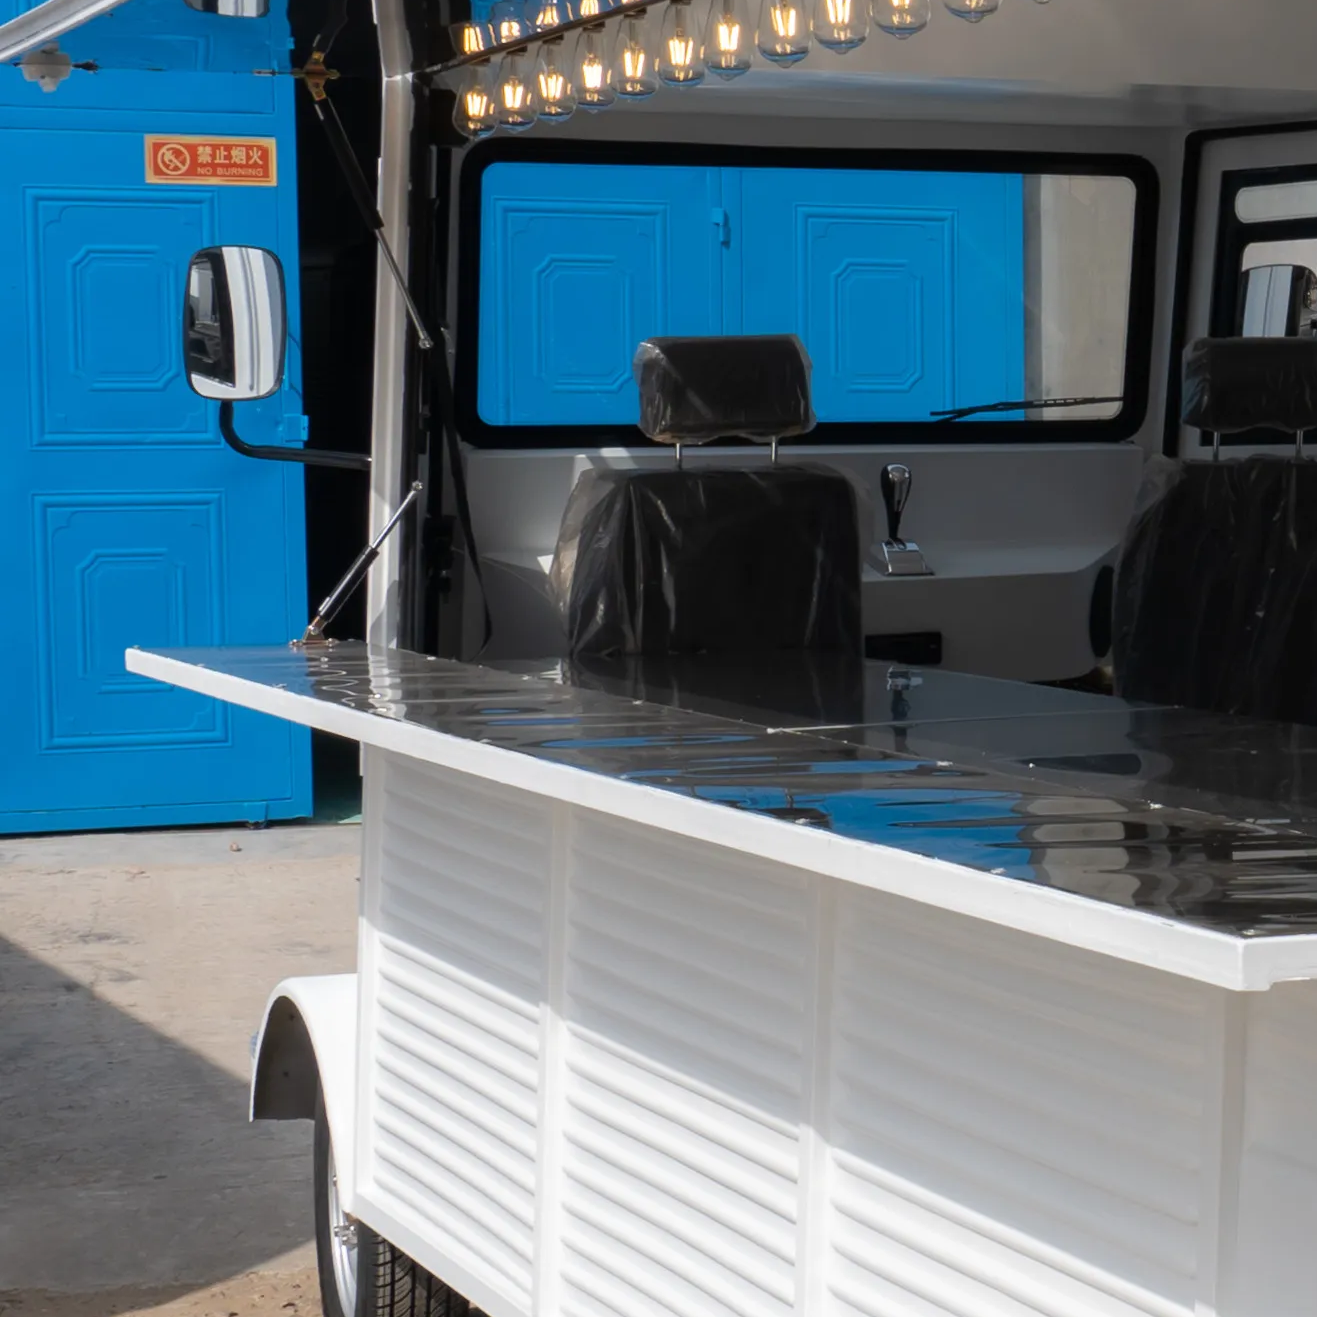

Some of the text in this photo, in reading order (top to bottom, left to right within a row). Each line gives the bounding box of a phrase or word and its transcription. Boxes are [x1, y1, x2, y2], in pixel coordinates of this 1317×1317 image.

[197, 145, 263, 164] 禁止烟火
[196, 166, 264, 177] NO BURNING
